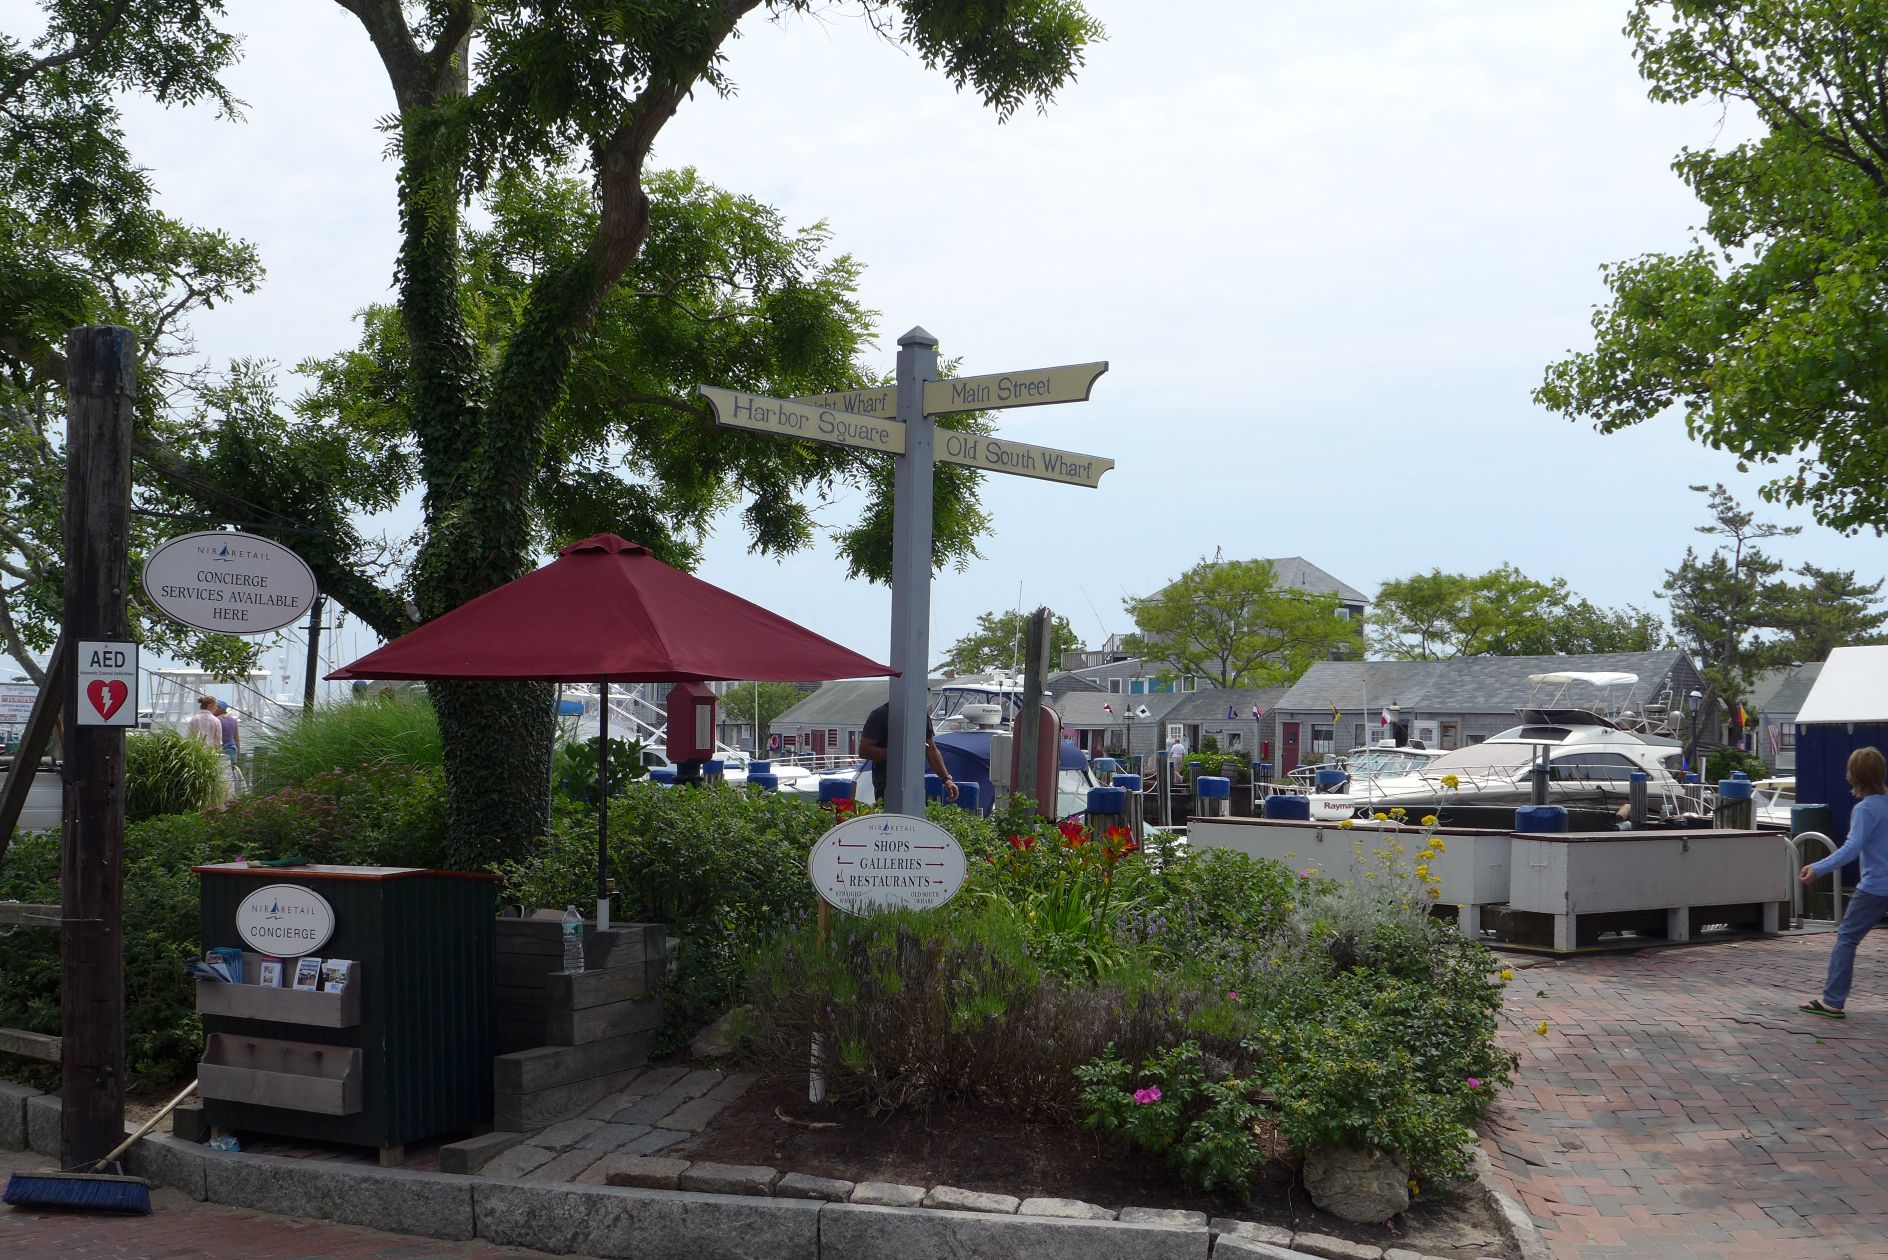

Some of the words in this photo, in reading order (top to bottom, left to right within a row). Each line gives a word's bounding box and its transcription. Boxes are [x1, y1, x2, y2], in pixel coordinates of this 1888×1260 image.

[951, 382, 991, 405] Main
[997, 376, 1051, 401] Street
[842, 392, 888, 414] Wharf
[733, 395, 810, 429] Harbor
[817, 410, 890, 444] Square
[946, 435, 978, 460] Old
[985, 441, 1036, 470] South
[1042, 451, 1093, 480] Wharf
[197, 546, 218, 554] NIR
[231, 551, 271, 561] RETAIL
[197, 570, 269, 588] CONCIERGE
[161, 585, 224, 602] SERVICES
[228, 591, 300, 608] AVAILABLE
[213, 607, 249, 622] HERE
[89, 650, 126, 668] AED
[873, 840, 910, 852] SHOPS
[859, 857, 922, 870] GALLERIES
[849, 875, 930, 887] RESTAURANTS
[251, 904, 269, 913] NIR
[280, 906, 316, 915] RETAIL
[250, 926, 317, 940] CONCIERGE
